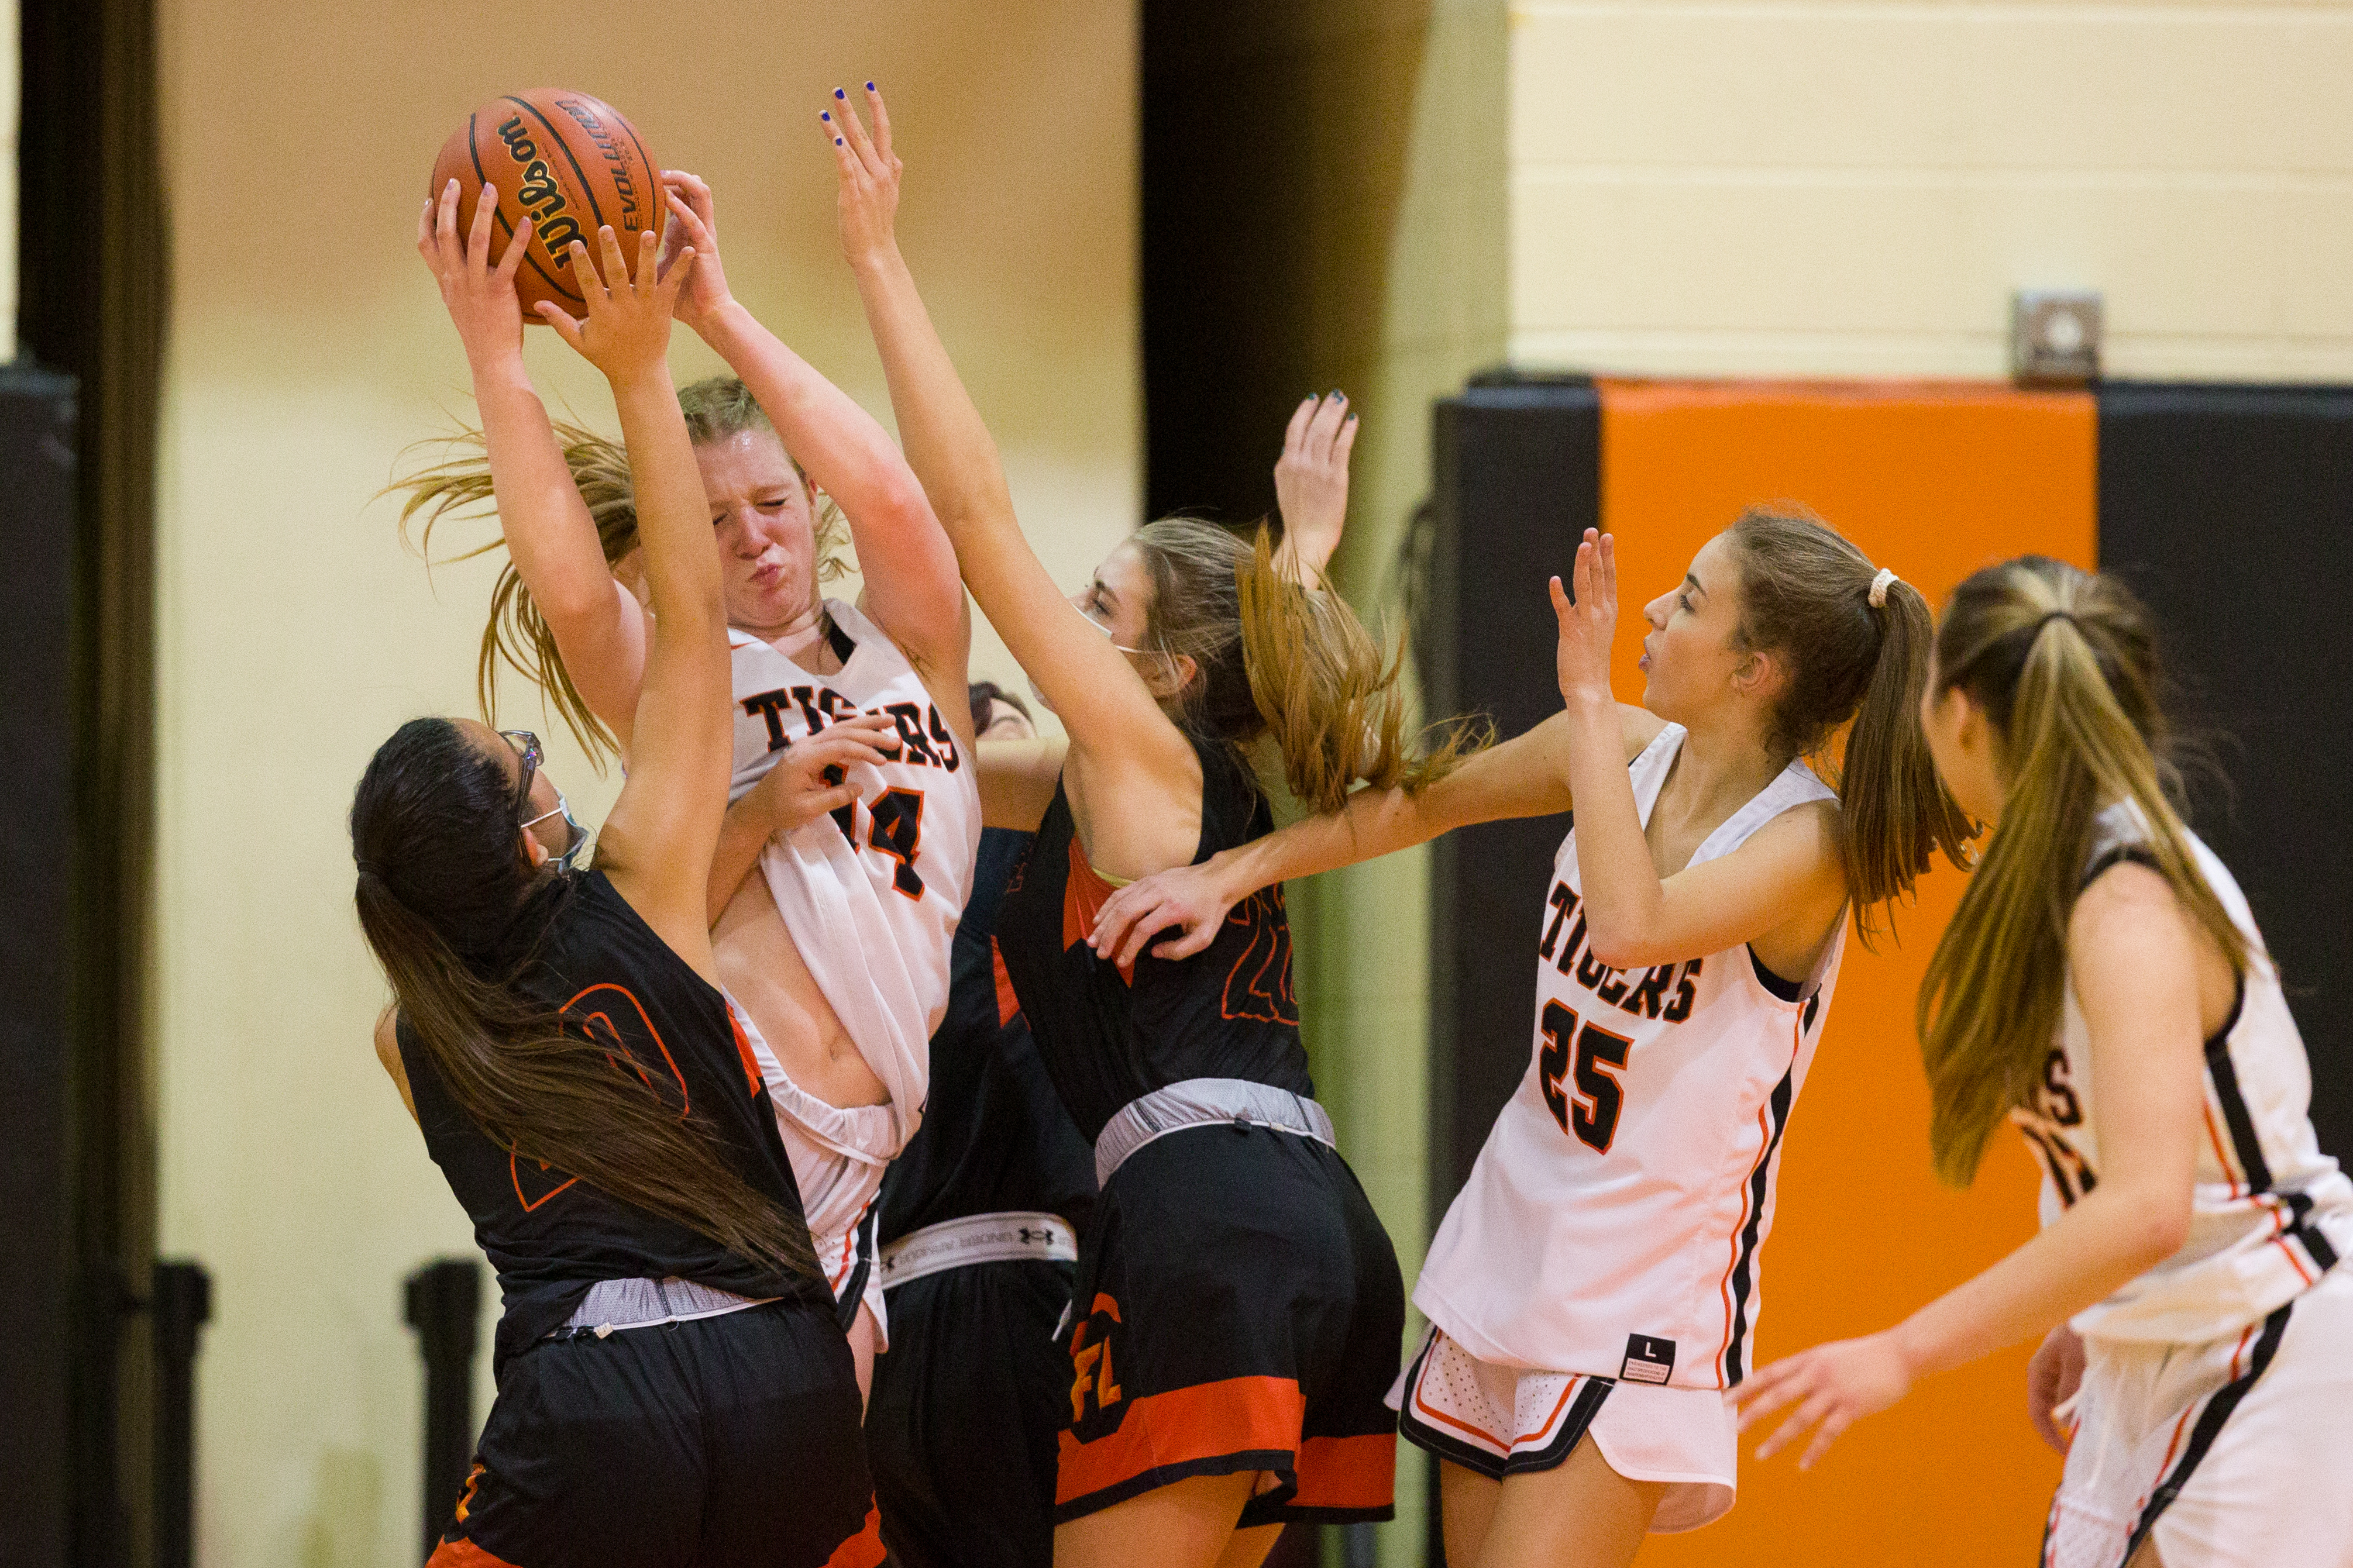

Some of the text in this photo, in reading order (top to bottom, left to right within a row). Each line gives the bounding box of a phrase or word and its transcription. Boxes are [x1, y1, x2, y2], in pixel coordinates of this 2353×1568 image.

[497, 115, 588, 271] Wilson
[1539, 997, 1635, 1155] 25
[1645, 1342, 1657, 1357] L
